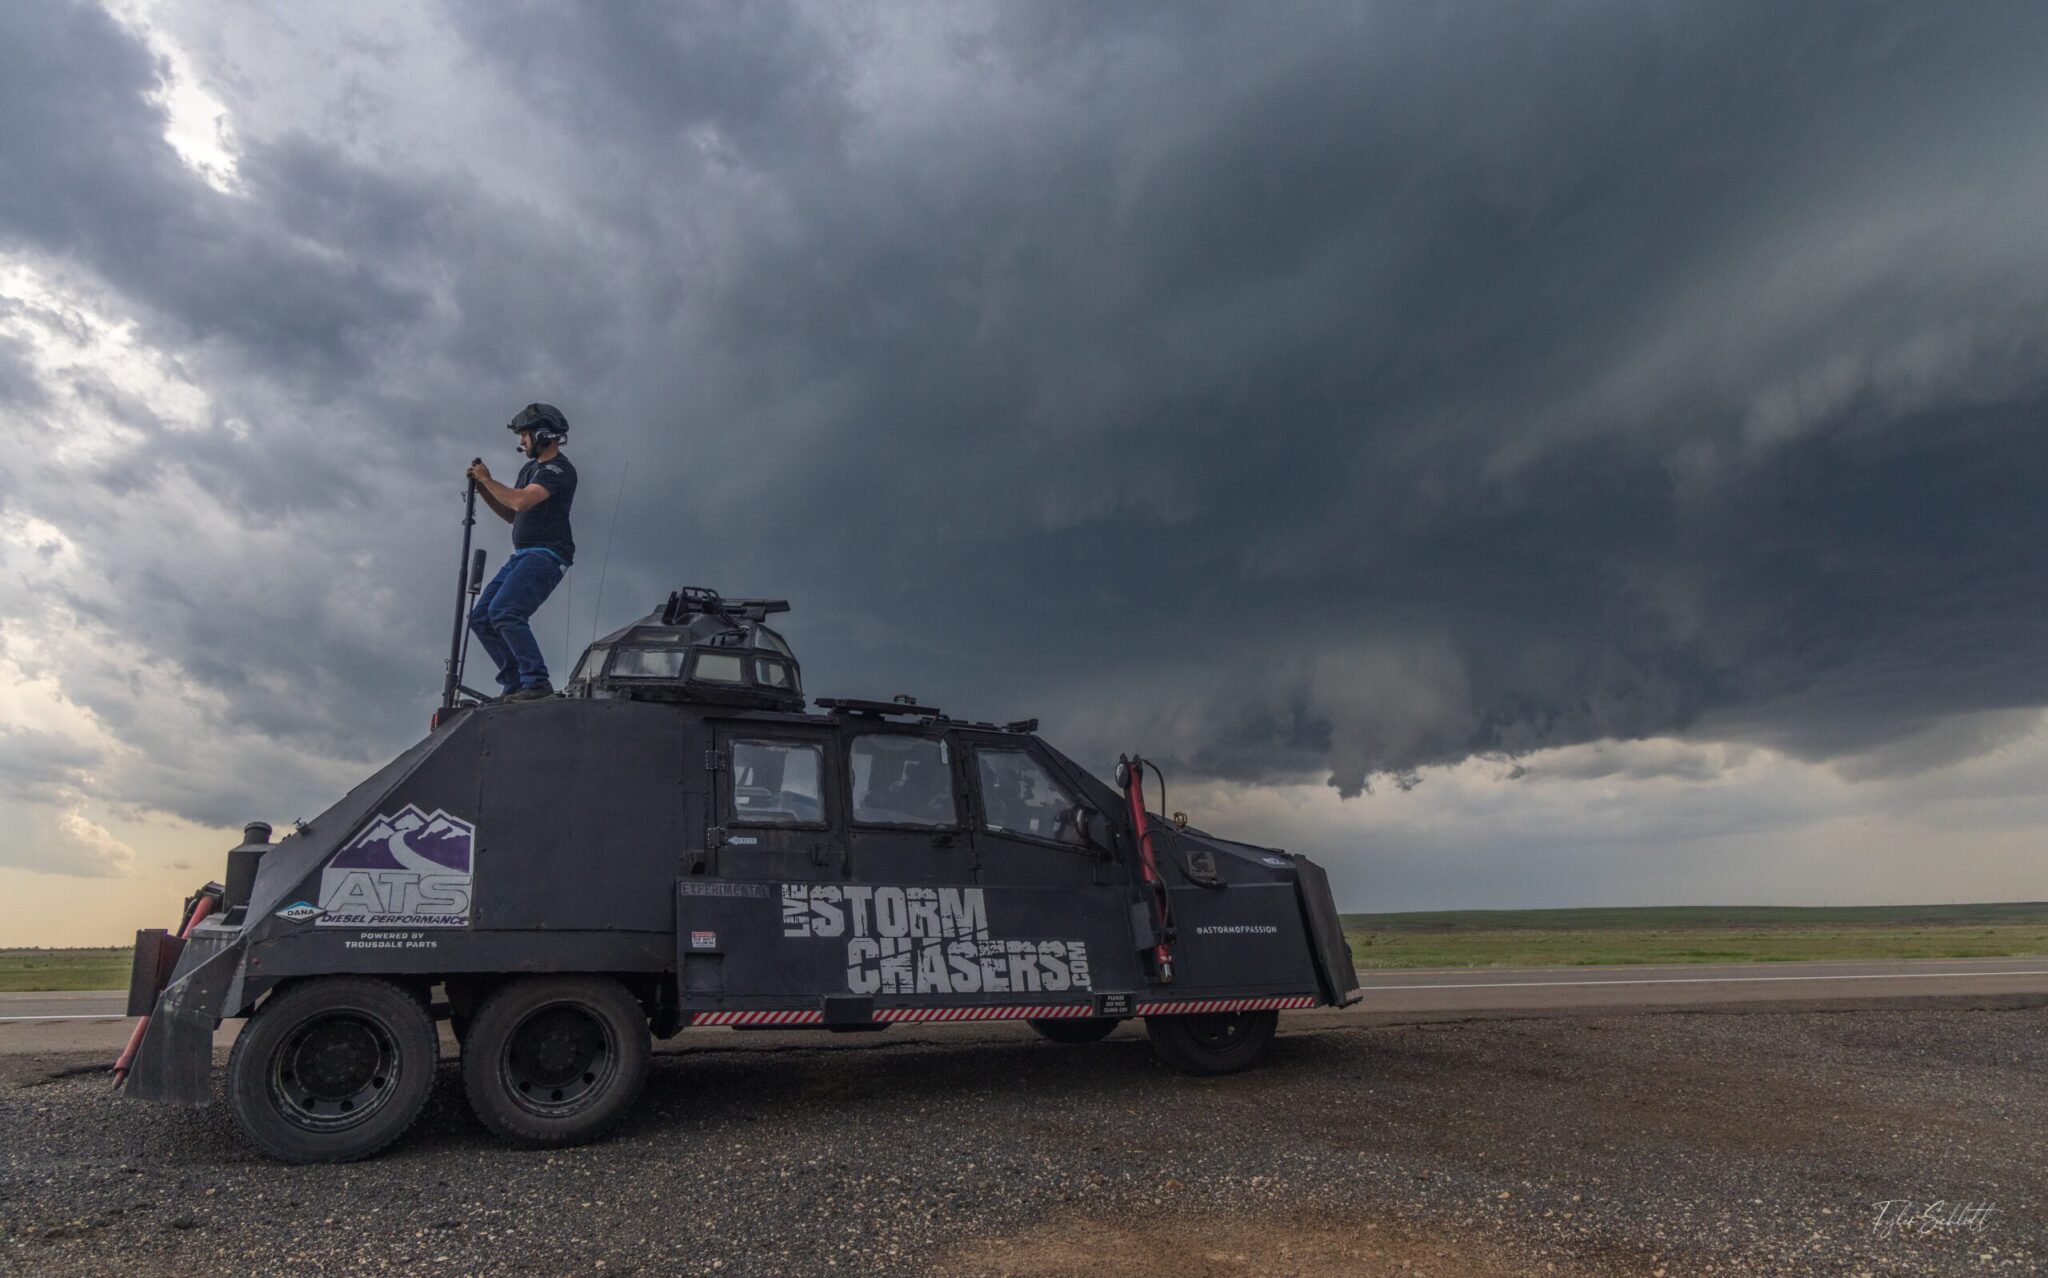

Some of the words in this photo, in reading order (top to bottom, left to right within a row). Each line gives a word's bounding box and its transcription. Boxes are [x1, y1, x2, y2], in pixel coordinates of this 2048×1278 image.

[324, 871, 472, 914] ATS
[681, 881, 769, 898] EXPERIMENTAL
[287, 908, 315, 917] DANA
[321, 914, 366, 923] DIESEL
[369, 914, 469, 925] PERFORMANCE
[781, 884, 811, 937] LIVE
[810, 885, 989, 940] STORM
[1196, 925, 1277, 934] @ASTORMOFPASSION
[847, 937, 1072, 993] CHASERS
